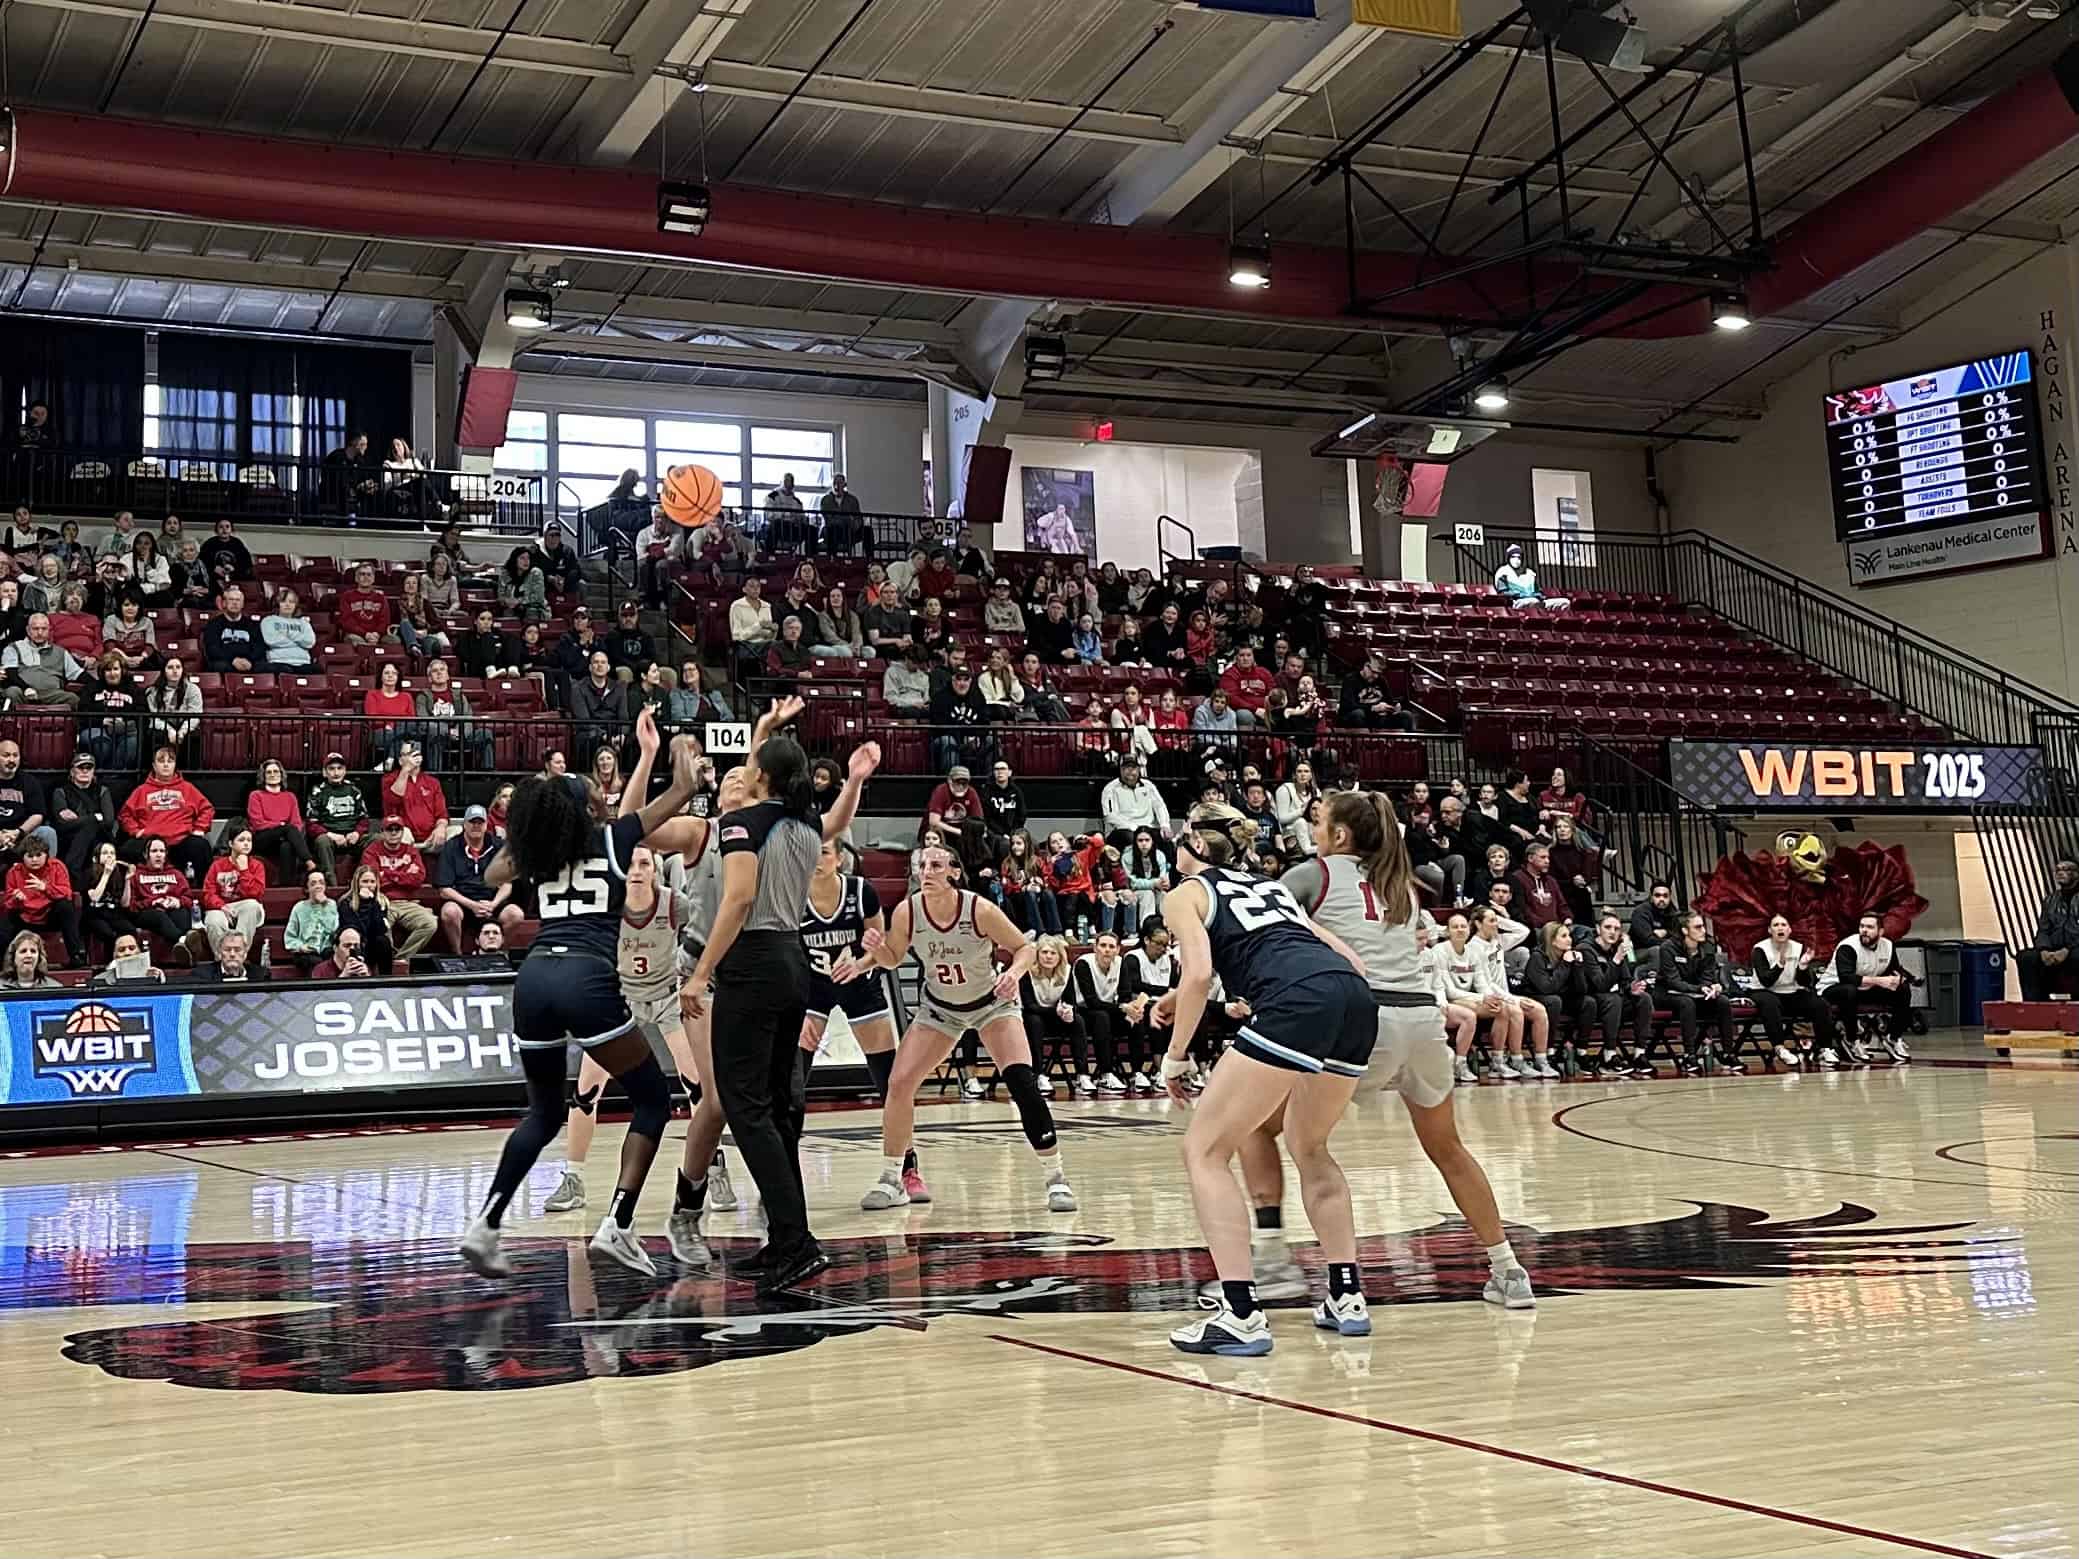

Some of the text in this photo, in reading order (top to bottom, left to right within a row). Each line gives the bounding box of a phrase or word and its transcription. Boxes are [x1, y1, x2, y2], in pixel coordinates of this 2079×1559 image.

[2040, 310, 2063, 422] HAGAN
[1983, 390, 2008, 407] 0 %
[954, 405, 970, 422] 205
[1985, 407, 2010, 423] 0 %
[1853, 420, 1876, 435] 0 %
[1986, 424, 2012, 440] 0 %
[1854, 436, 1877, 450] 0 %
[1993, 442, 2003, 455] 0
[1856, 451, 1879, 466] 0 %
[1995, 459, 2005, 472] 0
[1862, 469, 1871, 481] 0
[1996, 475, 2007, 489] 0
[493, 480, 527, 497] 204
[1863, 485, 1873, 497] 0
[1997, 492, 2008, 506] 0
[2053, 442, 2079, 554] ARENA
[1865, 501, 1875, 513] 0
[934, 521, 953, 537] 05
[1865, 517, 1875, 529] 0
[1458, 527, 1481, 541] 206
[1887, 524, 2035, 559] Lankenau Medical Center
[711, 728, 746, 748] 104
[1738, 750, 1987, 799] WBIT 2025
[537, 857, 610, 920] 25
[1215, 880, 1314, 932] 23
[632, 955, 649, 976] 3
[933, 961, 969, 986] 21
[313, 997, 504, 1036] SAINT
[37, 1035, 152, 1062] WBIT
